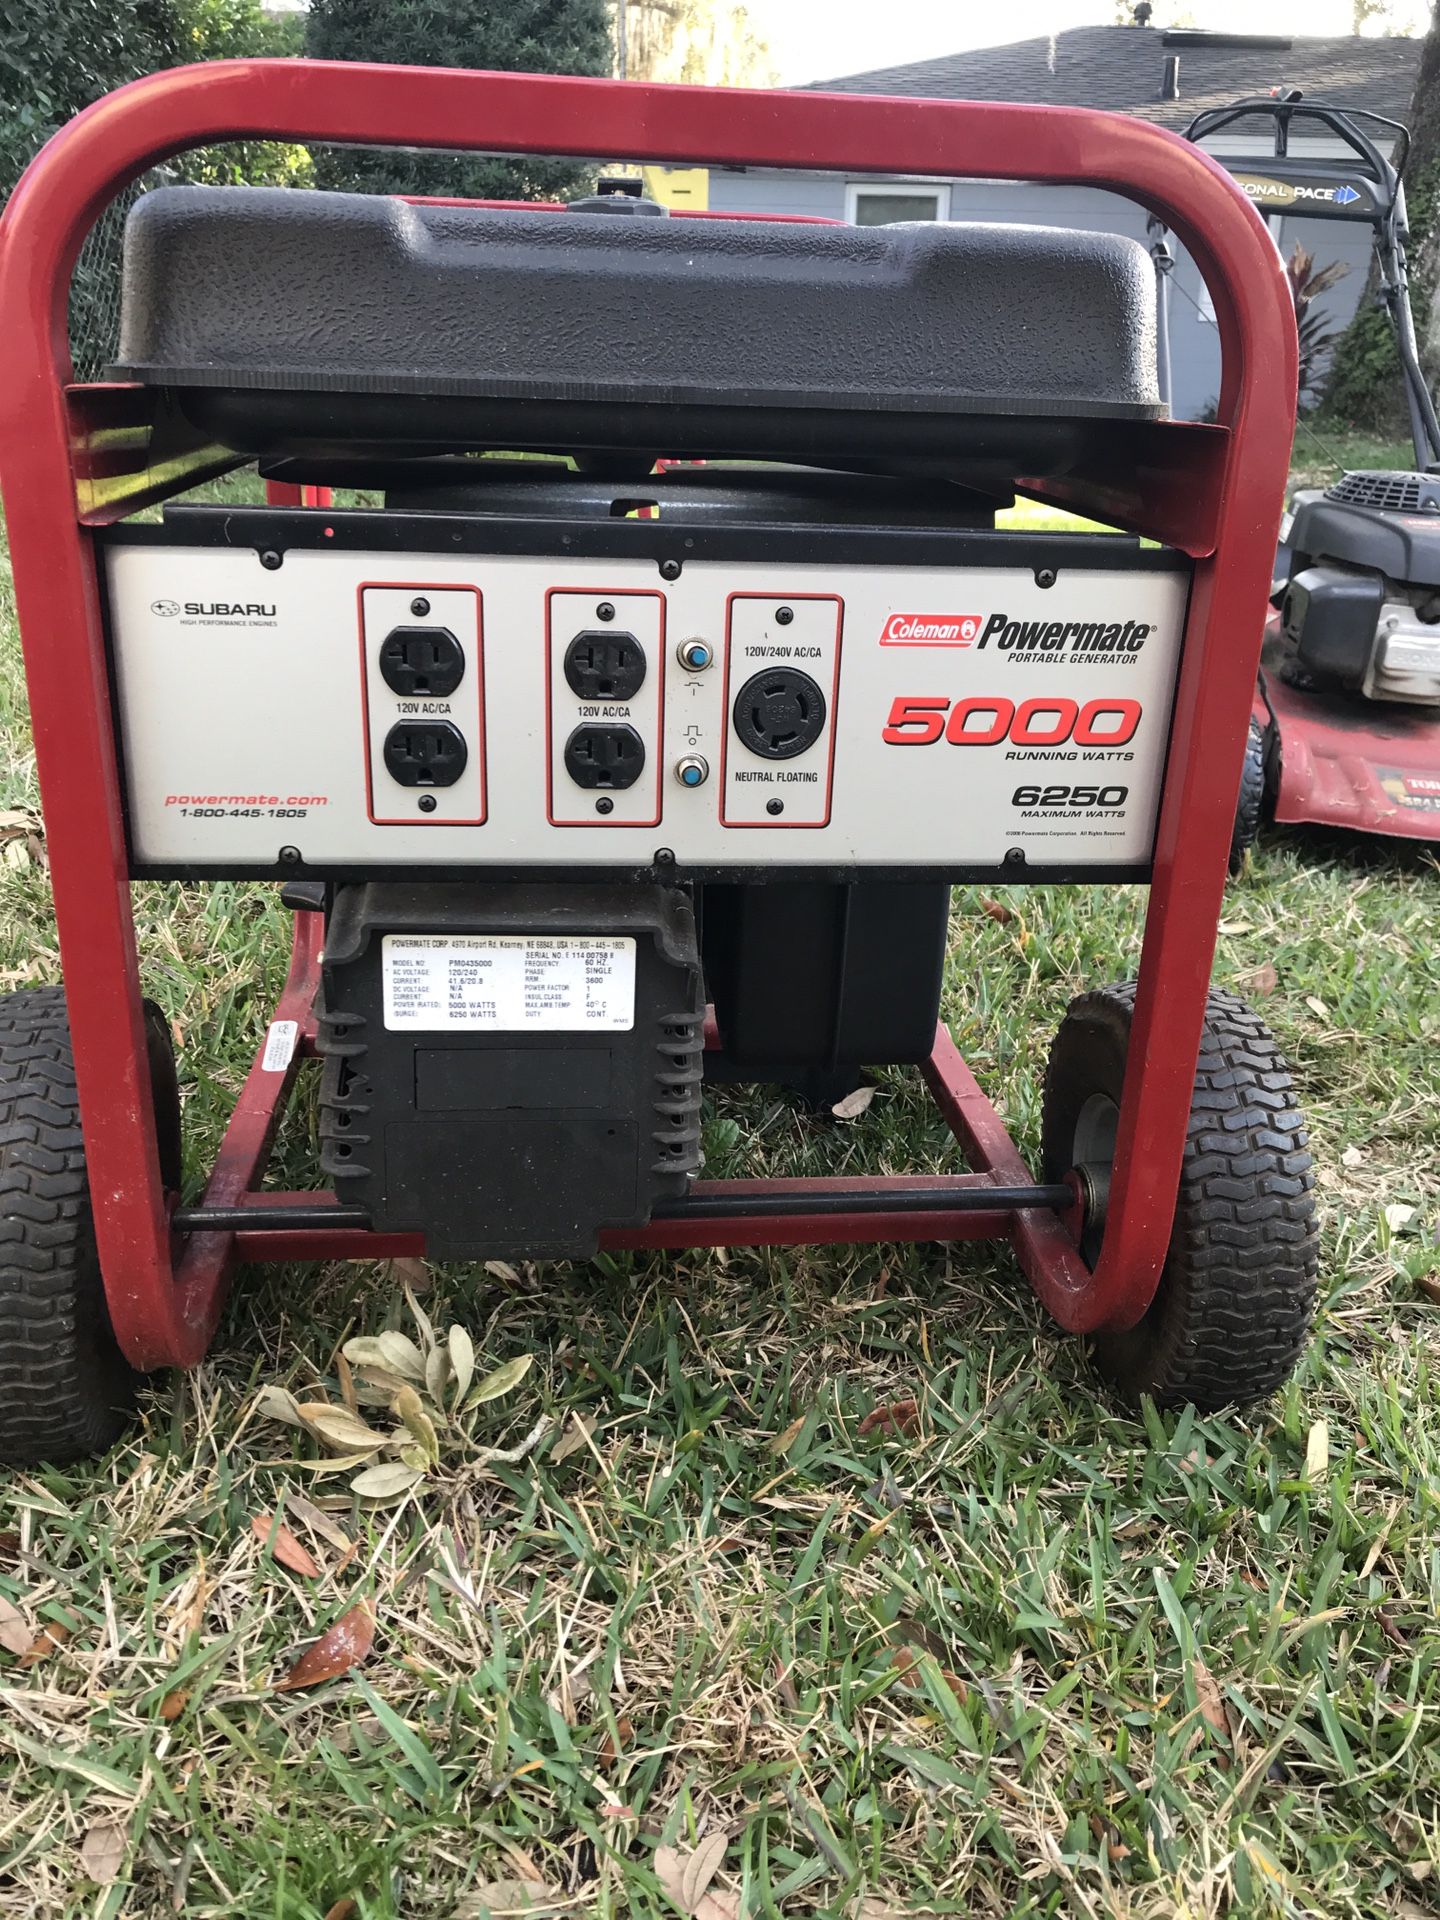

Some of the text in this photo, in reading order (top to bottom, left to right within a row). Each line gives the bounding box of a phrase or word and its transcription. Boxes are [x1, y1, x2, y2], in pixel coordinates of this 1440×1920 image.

[1293, 187, 1335, 200] PACE
[184, 603, 276, 616] SUBARU
[888, 617, 960, 639] Coleman
[744, 646, 822, 658] 120V/240V AC/CA
[1008, 652, 1138, 664] PORTABLE GENERATOR
[396, 703, 451, 714] 120V AC/CA
[578, 706, 630, 718] 120V AC/CA
[882, 697, 1142, 747] 5000
[1005, 752, 1134, 761] RUNNING WATTS
[735, 772, 818, 783] NEUTRAL FLOATING
[164, 795, 328, 806] powermate.com
[1012, 786, 1129, 806] 6250
[180, 808, 307, 818] 1-800-445-1805
[392, 940, 430, 948] POWERMATE
[467, 940, 486, 949] Airport
